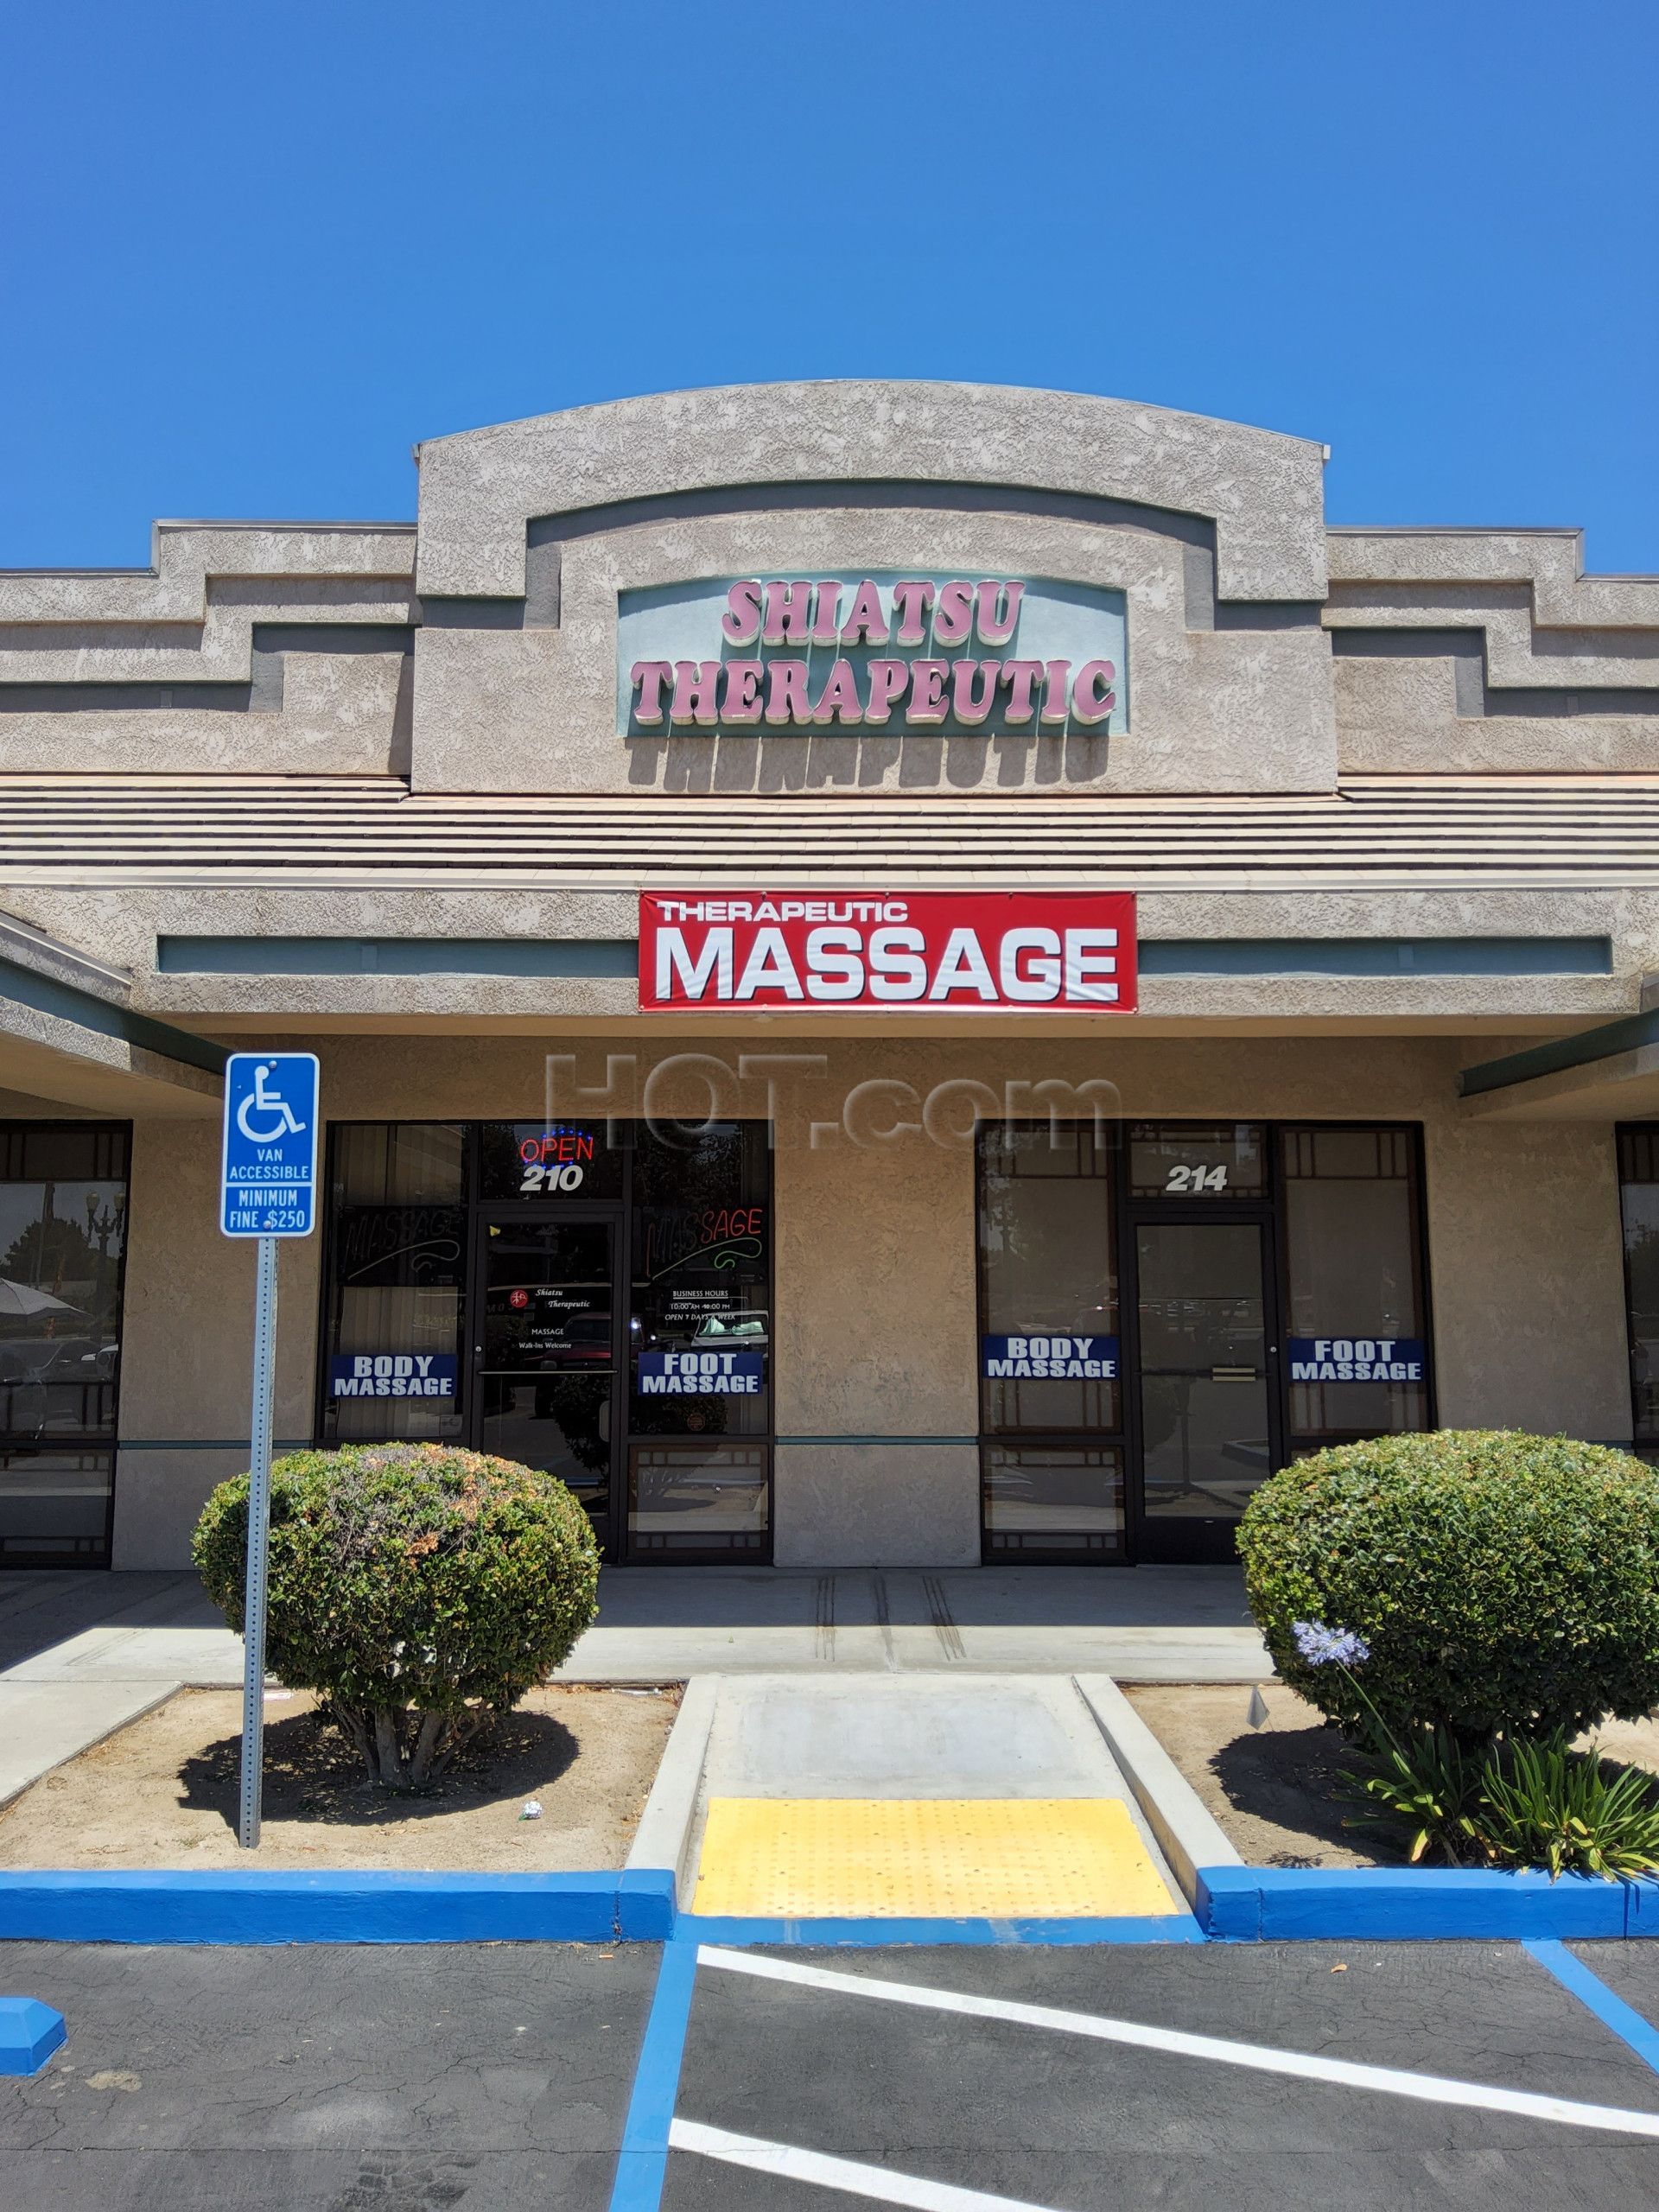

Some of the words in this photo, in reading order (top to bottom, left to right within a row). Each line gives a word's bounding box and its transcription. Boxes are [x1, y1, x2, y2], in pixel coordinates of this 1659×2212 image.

[722, 581, 1026, 646] SHIATSU
[631, 658, 1116, 725] THERAPEUTIC
[657, 901, 908, 922] THERAPEUTIC
[655, 927, 1119, 1001] MASSAGE
[257, 1149, 283, 1162] VAN
[520, 1137, 594, 1161] OPEN
[230, 1166, 308, 1179] ACCESSIBLE
[519, 1165, 583, 1191] 210
[1166, 1165, 1227, 1191] 214
[238, 1190, 297, 1207] MINIMUM
[230, 1211, 258, 1228] FINE
[268, 1210, 305, 1230] $250
[548, 1300, 591, 1309] Therapeutic
[1007, 1338, 1093, 1359] BODY
[1315, 1340, 1395, 1362] FOOT
[354, 1356, 434, 1377] BODY
[664, 1353, 737, 1375] FOOT
[988, 1359, 1116, 1377] MASSAGE
[1292, 1363, 1421, 1380] MASSAGE
[334, 1378, 452, 1395] MASSAGE
[643, 1376, 758, 1393] MASSAGE
